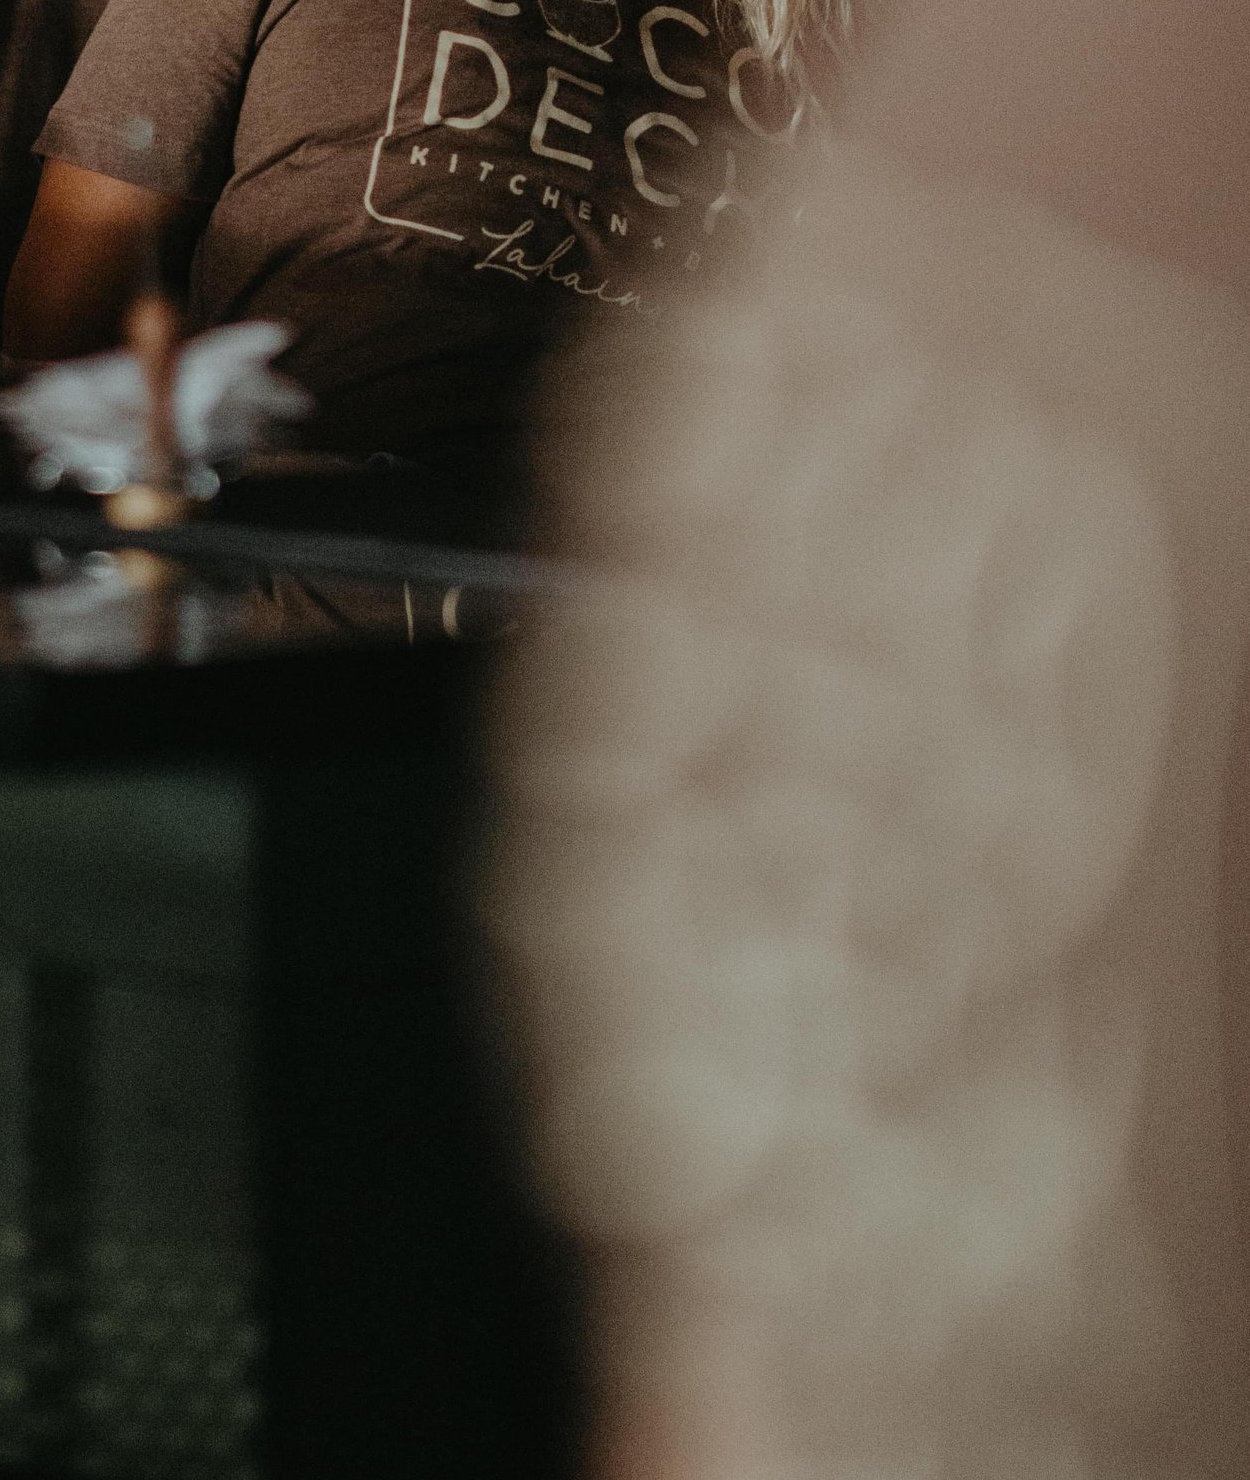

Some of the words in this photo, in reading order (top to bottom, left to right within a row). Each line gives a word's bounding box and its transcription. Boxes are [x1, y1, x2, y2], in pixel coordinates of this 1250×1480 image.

[422, 29, 740, 235] DEC
[409, 144, 629, 236] KITCHEN
[473, 219, 645, 310] Lahain
